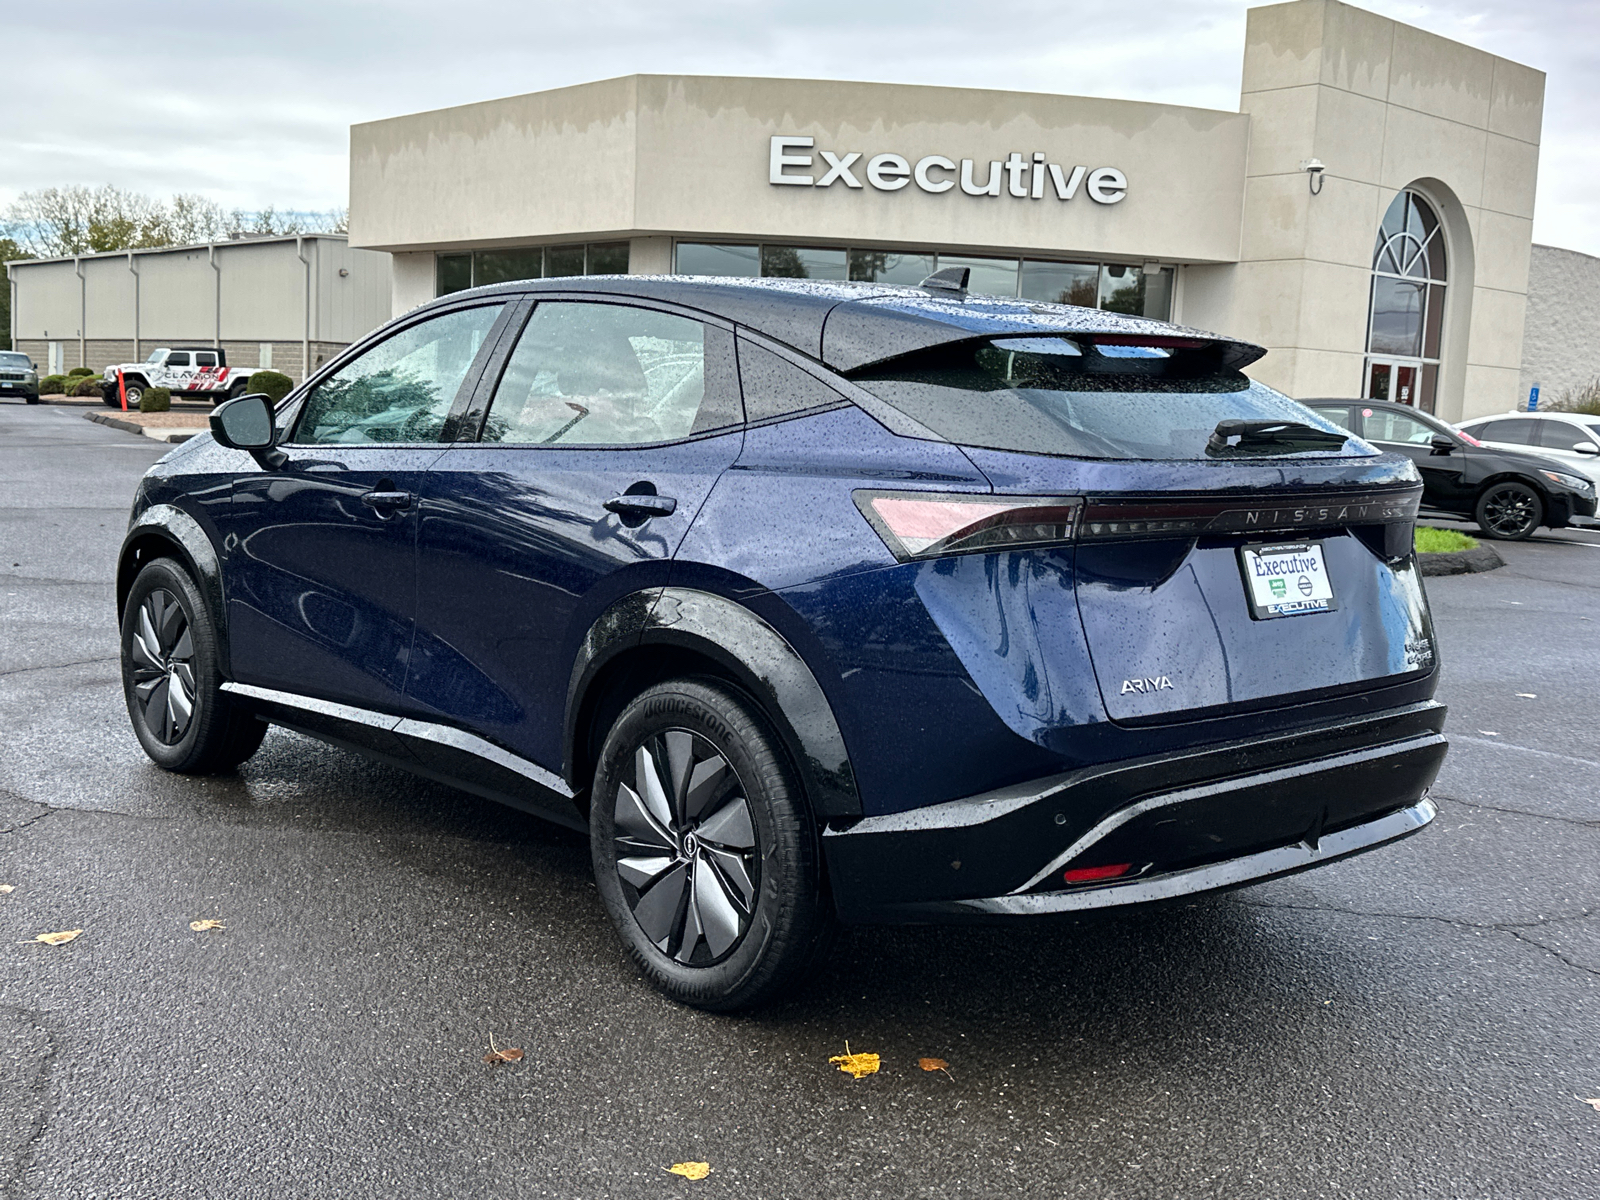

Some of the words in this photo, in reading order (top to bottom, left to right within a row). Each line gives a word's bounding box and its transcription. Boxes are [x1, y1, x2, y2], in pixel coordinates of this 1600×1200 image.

[769, 134, 1128, 204] Executive
[1245, 506, 1368, 524] NISSAN
[1252, 553, 1318, 576] Executive
[1267, 599, 1328, 613] EXECUTIVE
[1120, 676, 1174, 696] ARIYA
[643, 698, 734, 745] BRIDGESTONE
